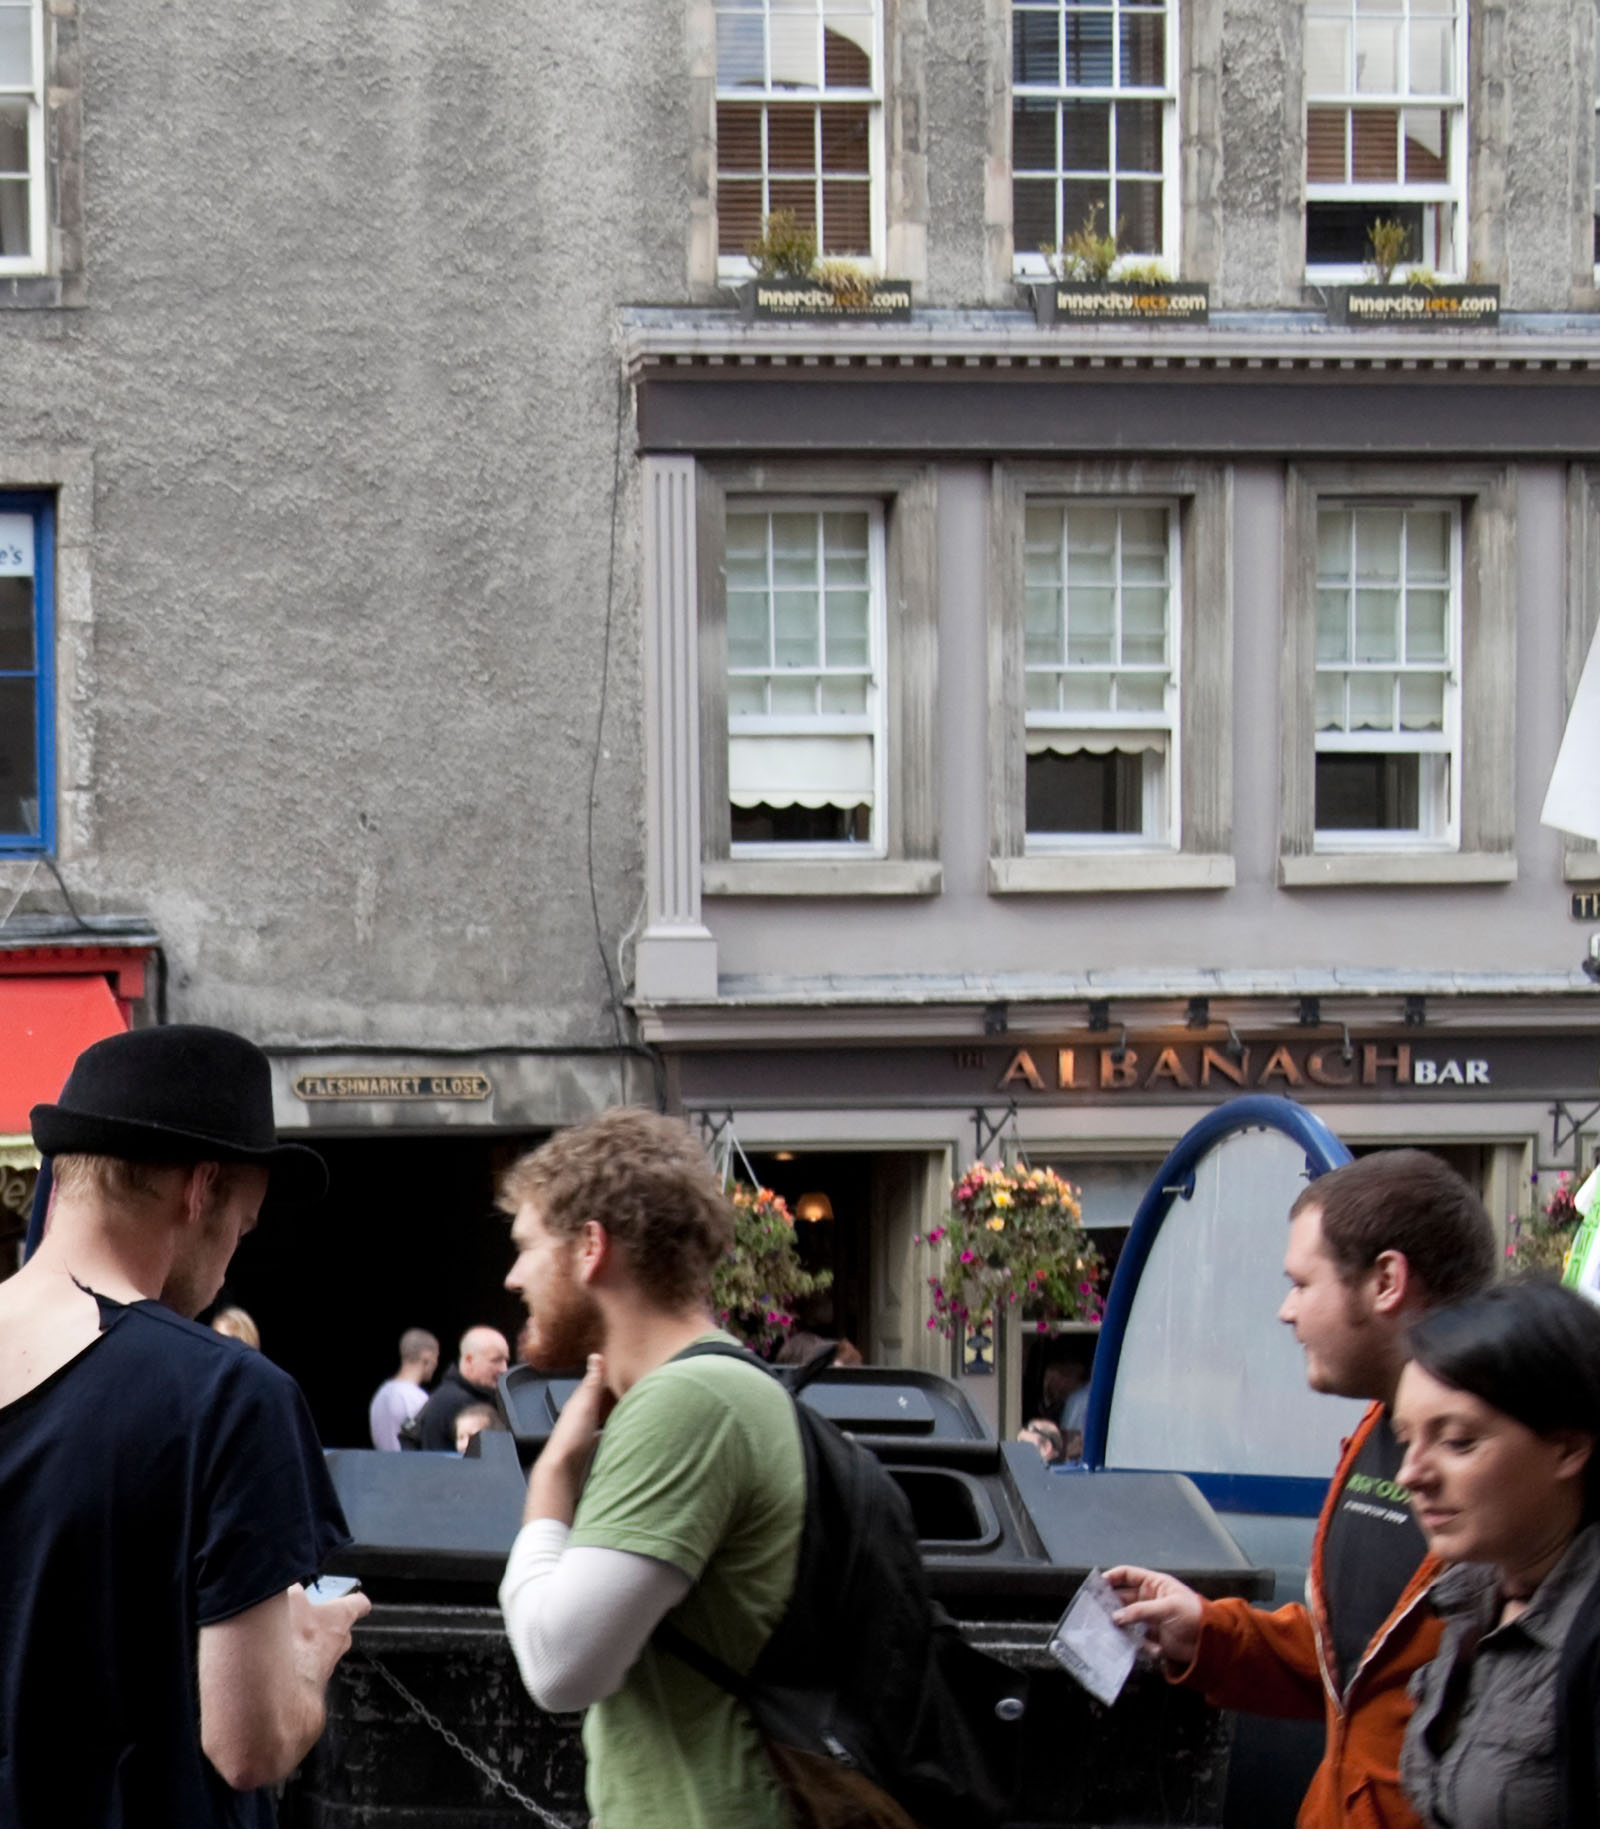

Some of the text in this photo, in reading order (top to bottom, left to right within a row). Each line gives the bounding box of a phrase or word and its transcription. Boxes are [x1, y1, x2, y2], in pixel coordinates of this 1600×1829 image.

[1349, 295, 1497, 313] innercitylets.com
[998, 1044, 1412, 1090] ALBANACH
[1414, 1059, 1491, 1086] BAR
[305, 1077, 481, 1095] FLESHMARKET CLOSE
